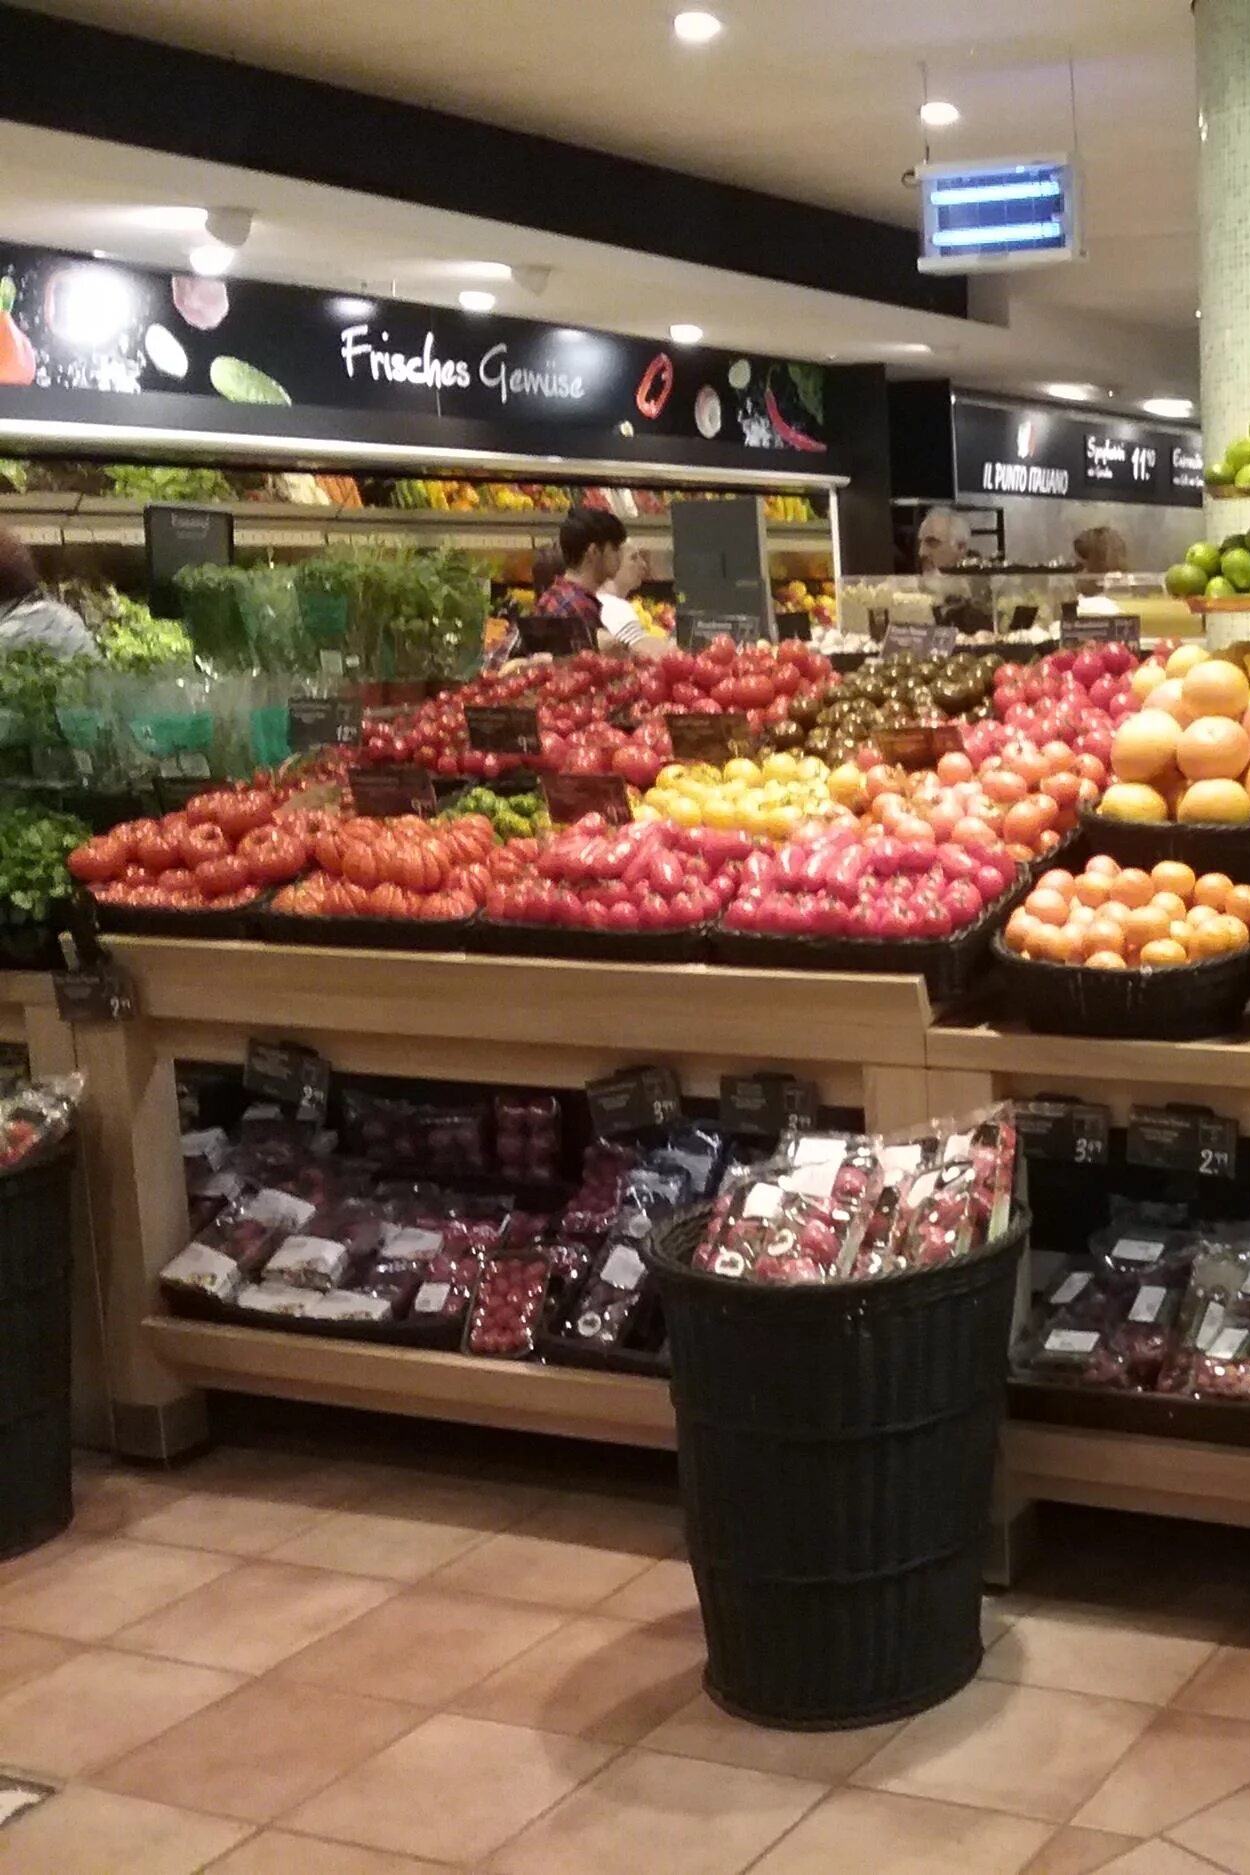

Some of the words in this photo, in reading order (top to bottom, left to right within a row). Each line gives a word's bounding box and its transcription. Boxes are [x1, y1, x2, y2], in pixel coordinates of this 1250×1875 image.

[341, 323, 471, 391] Frisches
[479, 343, 586, 404] Gemüse
[982, 462, 994, 490] IL
[995, 463, 1028, 493] PUNTO
[1028, 466, 1069, 495] ITALIANO
[1074, 1137, 1103, 1163] 3.99
[1199, 1148, 1229, 1174] 2.99
